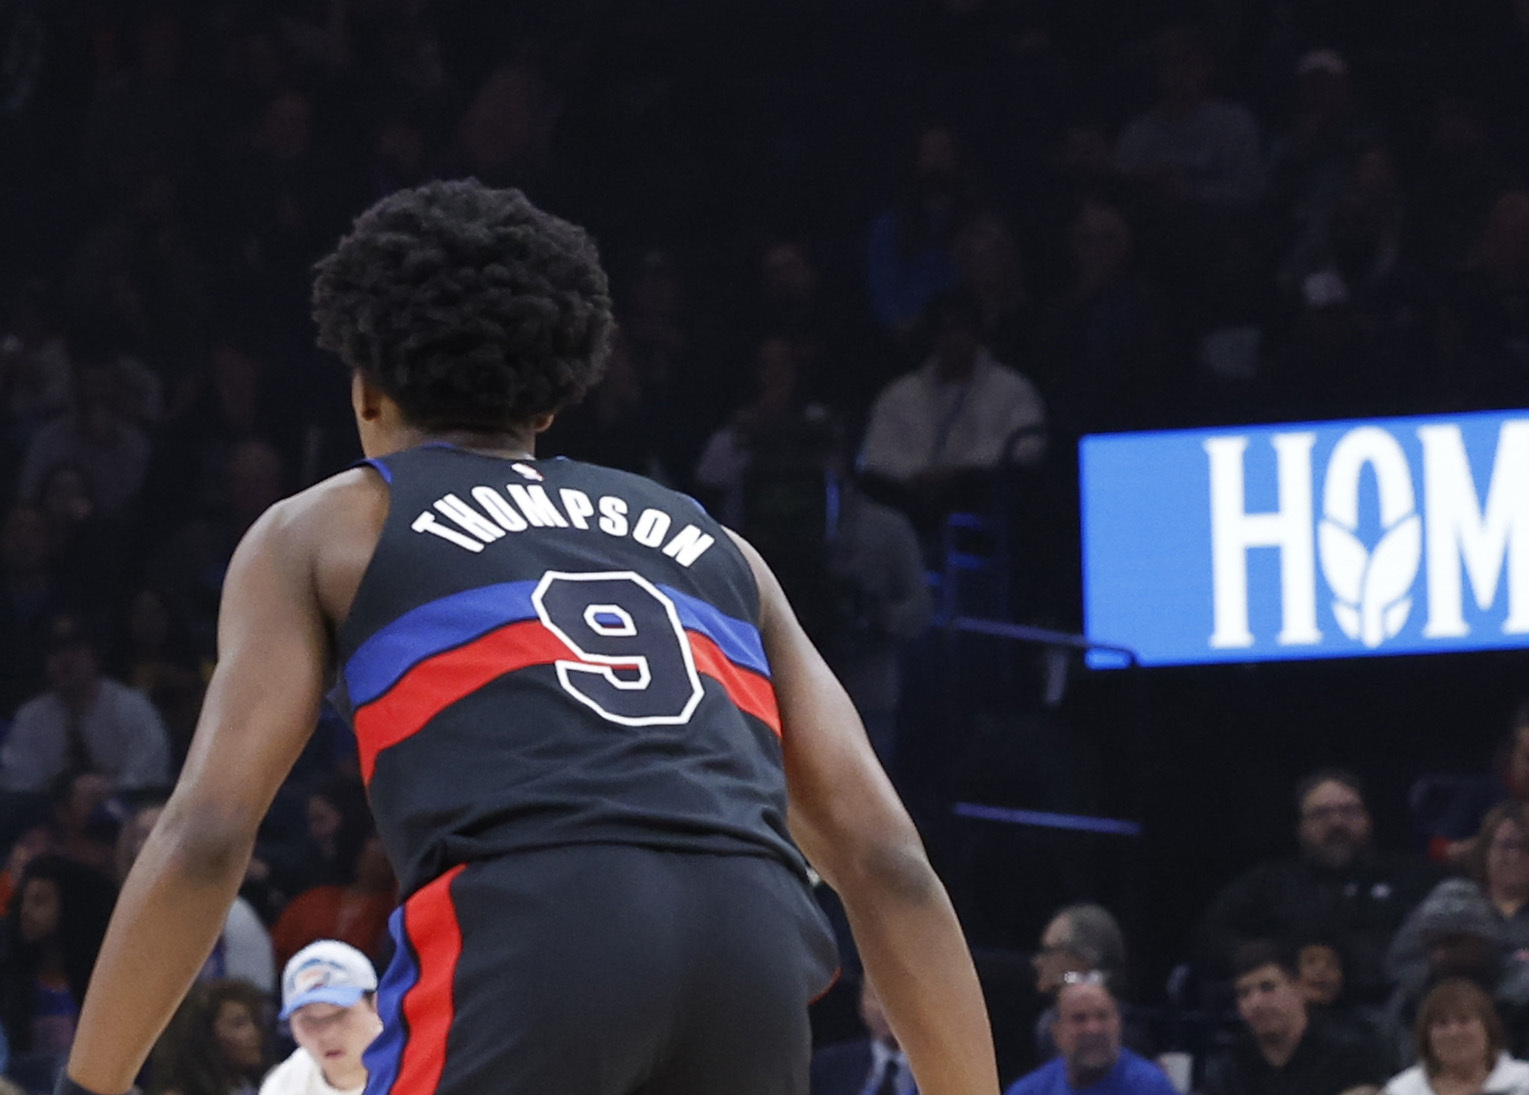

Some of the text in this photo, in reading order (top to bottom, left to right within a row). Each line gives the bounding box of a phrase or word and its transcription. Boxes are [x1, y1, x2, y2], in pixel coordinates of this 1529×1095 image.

[411, 483, 715, 568] THOMPSON
[1202, 419, 1529, 648] HOM
[531, 570, 704, 727] 9
